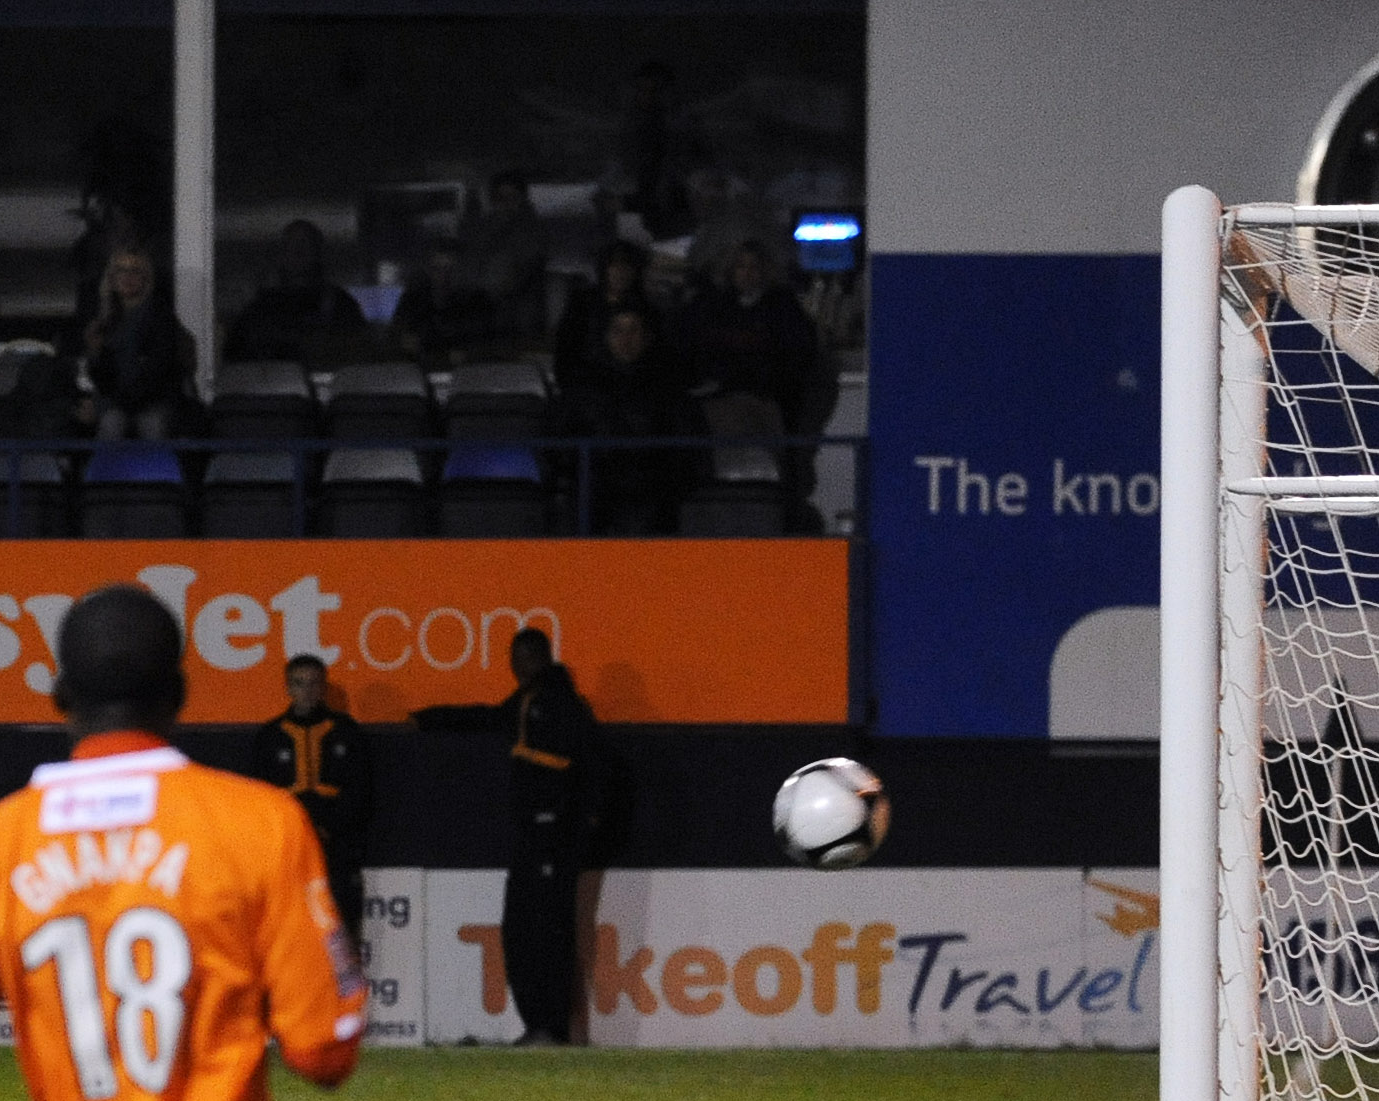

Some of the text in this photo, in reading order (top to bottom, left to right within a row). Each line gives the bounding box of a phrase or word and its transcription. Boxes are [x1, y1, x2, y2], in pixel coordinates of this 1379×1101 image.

[914, 456, 1162, 516] The kno
[21, 906, 193, 1100] 18
[458, 922, 896, 1016] Tkeoff
[898, 931, 1155, 1016] Travel
